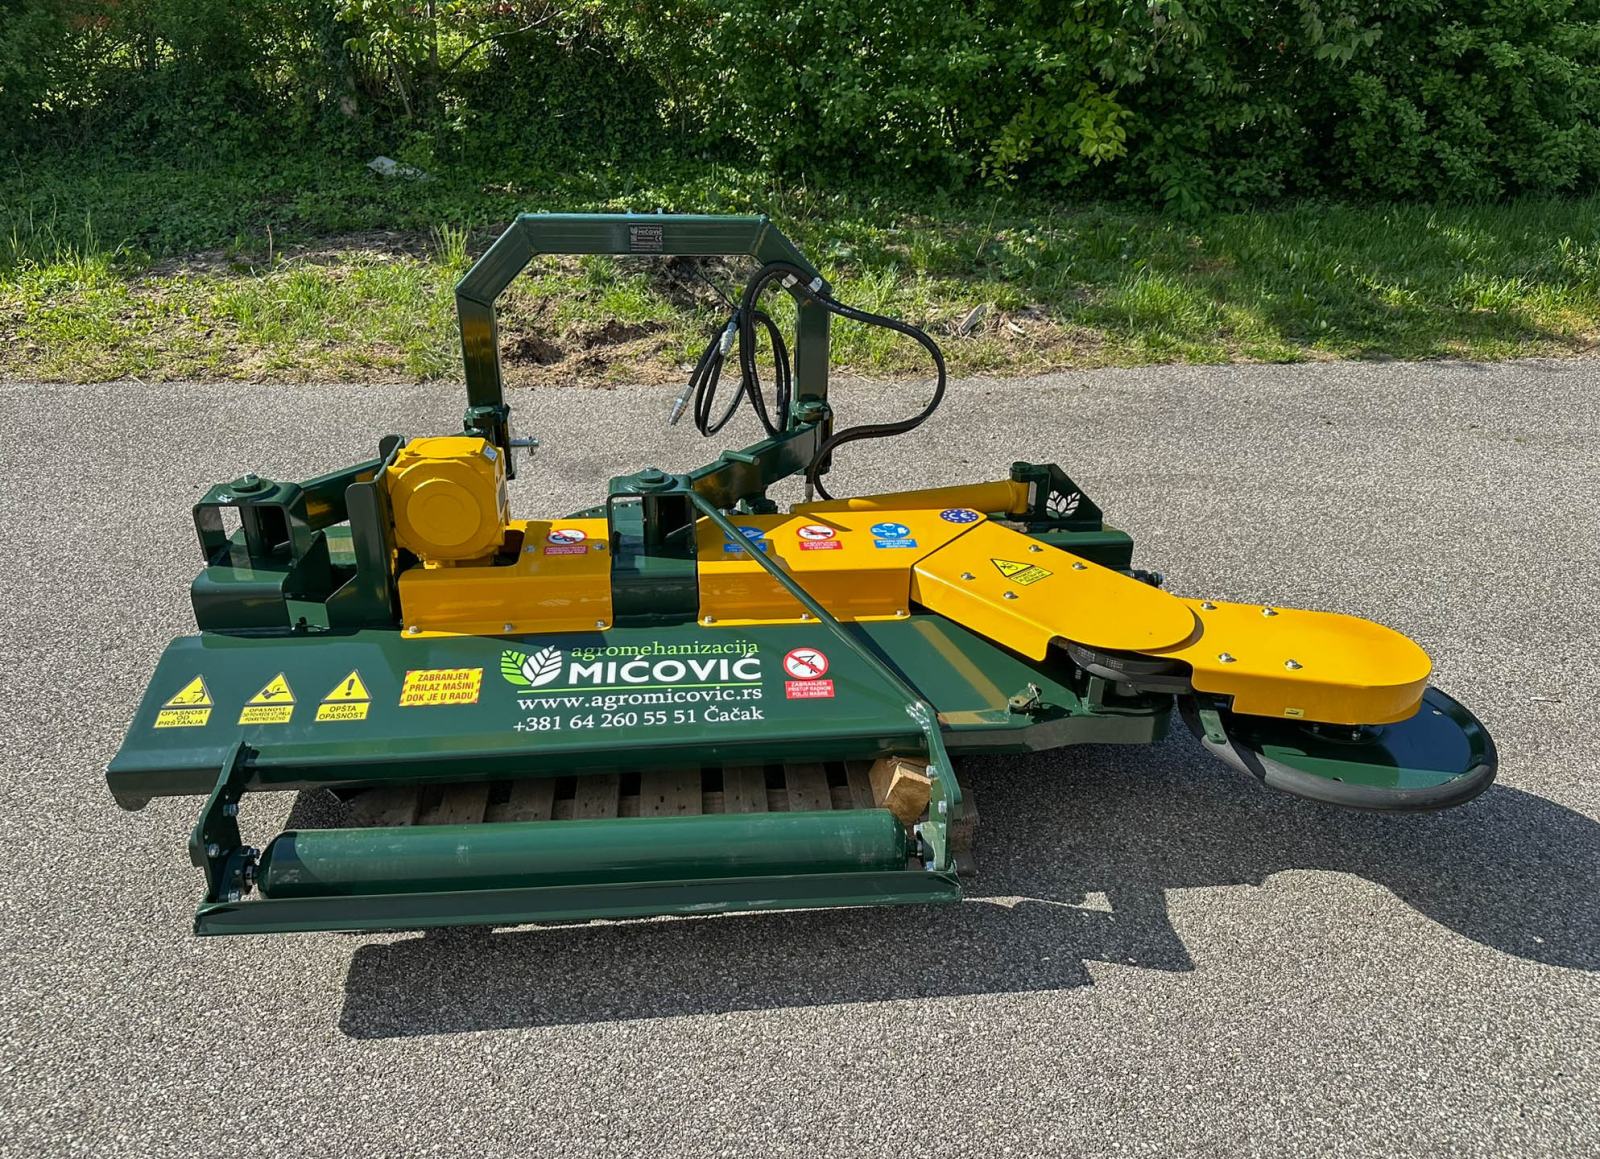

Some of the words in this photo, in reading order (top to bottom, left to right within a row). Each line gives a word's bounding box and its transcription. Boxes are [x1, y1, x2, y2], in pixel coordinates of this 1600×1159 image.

[571, 640, 760, 661] agromehanizacija
[568, 652, 762, 684] MIĆOVIĆ
[418, 673, 470, 682] ZABRANJEN
[409, 683, 440, 692] PRILAZ
[442, 681, 474, 691] MAŠINI
[406, 693, 424, 702] DOK
[427, 693, 438, 701] JE
[440, 692, 447, 701] U
[449, 692, 473, 700] RADU
[517, 685, 763, 711] www.agromicovic.rs
[161, 709, 208, 717] OPASNOST
[329, 705, 357, 713] OPŠTA
[318, 712, 364, 720] OPASNOST
[513, 716, 562, 732] +381
[569, 714, 595, 729] 64
[601, 713, 638, 727] 260
[643, 711, 667, 725] 55
[673, 709, 697, 724] 51
[704, 705, 765, 722] Čačak
